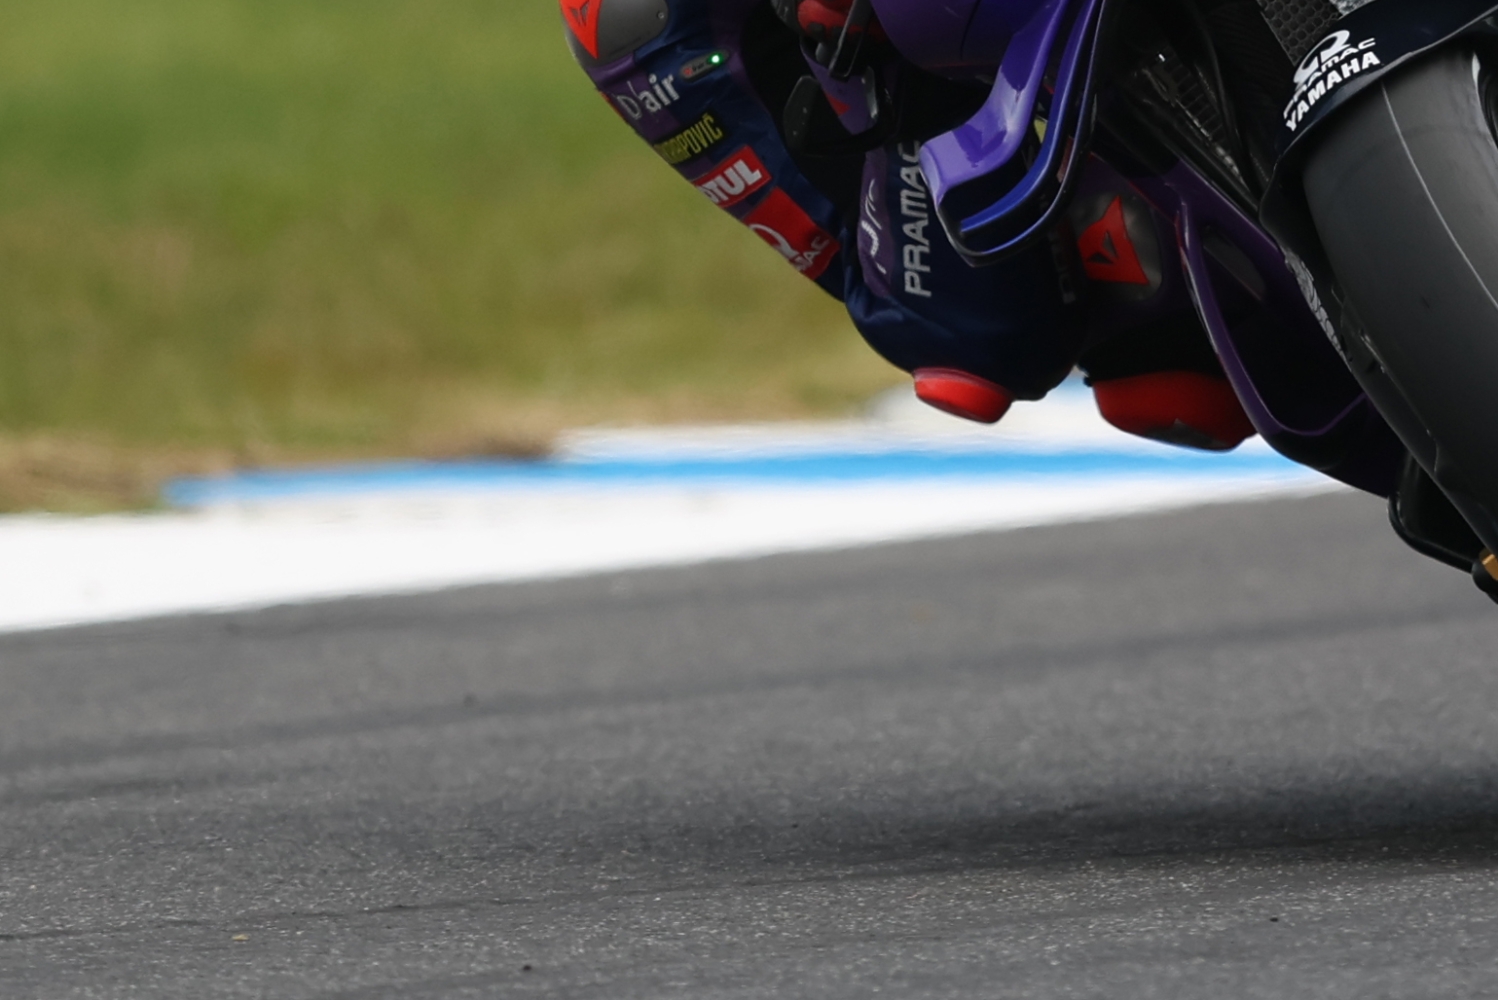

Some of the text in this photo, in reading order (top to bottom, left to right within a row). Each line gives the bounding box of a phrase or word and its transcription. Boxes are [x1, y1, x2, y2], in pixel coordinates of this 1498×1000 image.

[1286, 51, 1381, 132] YAMAHA
[697, 159, 763, 204] TUL
[898, 139, 932, 298] PRAMAC
